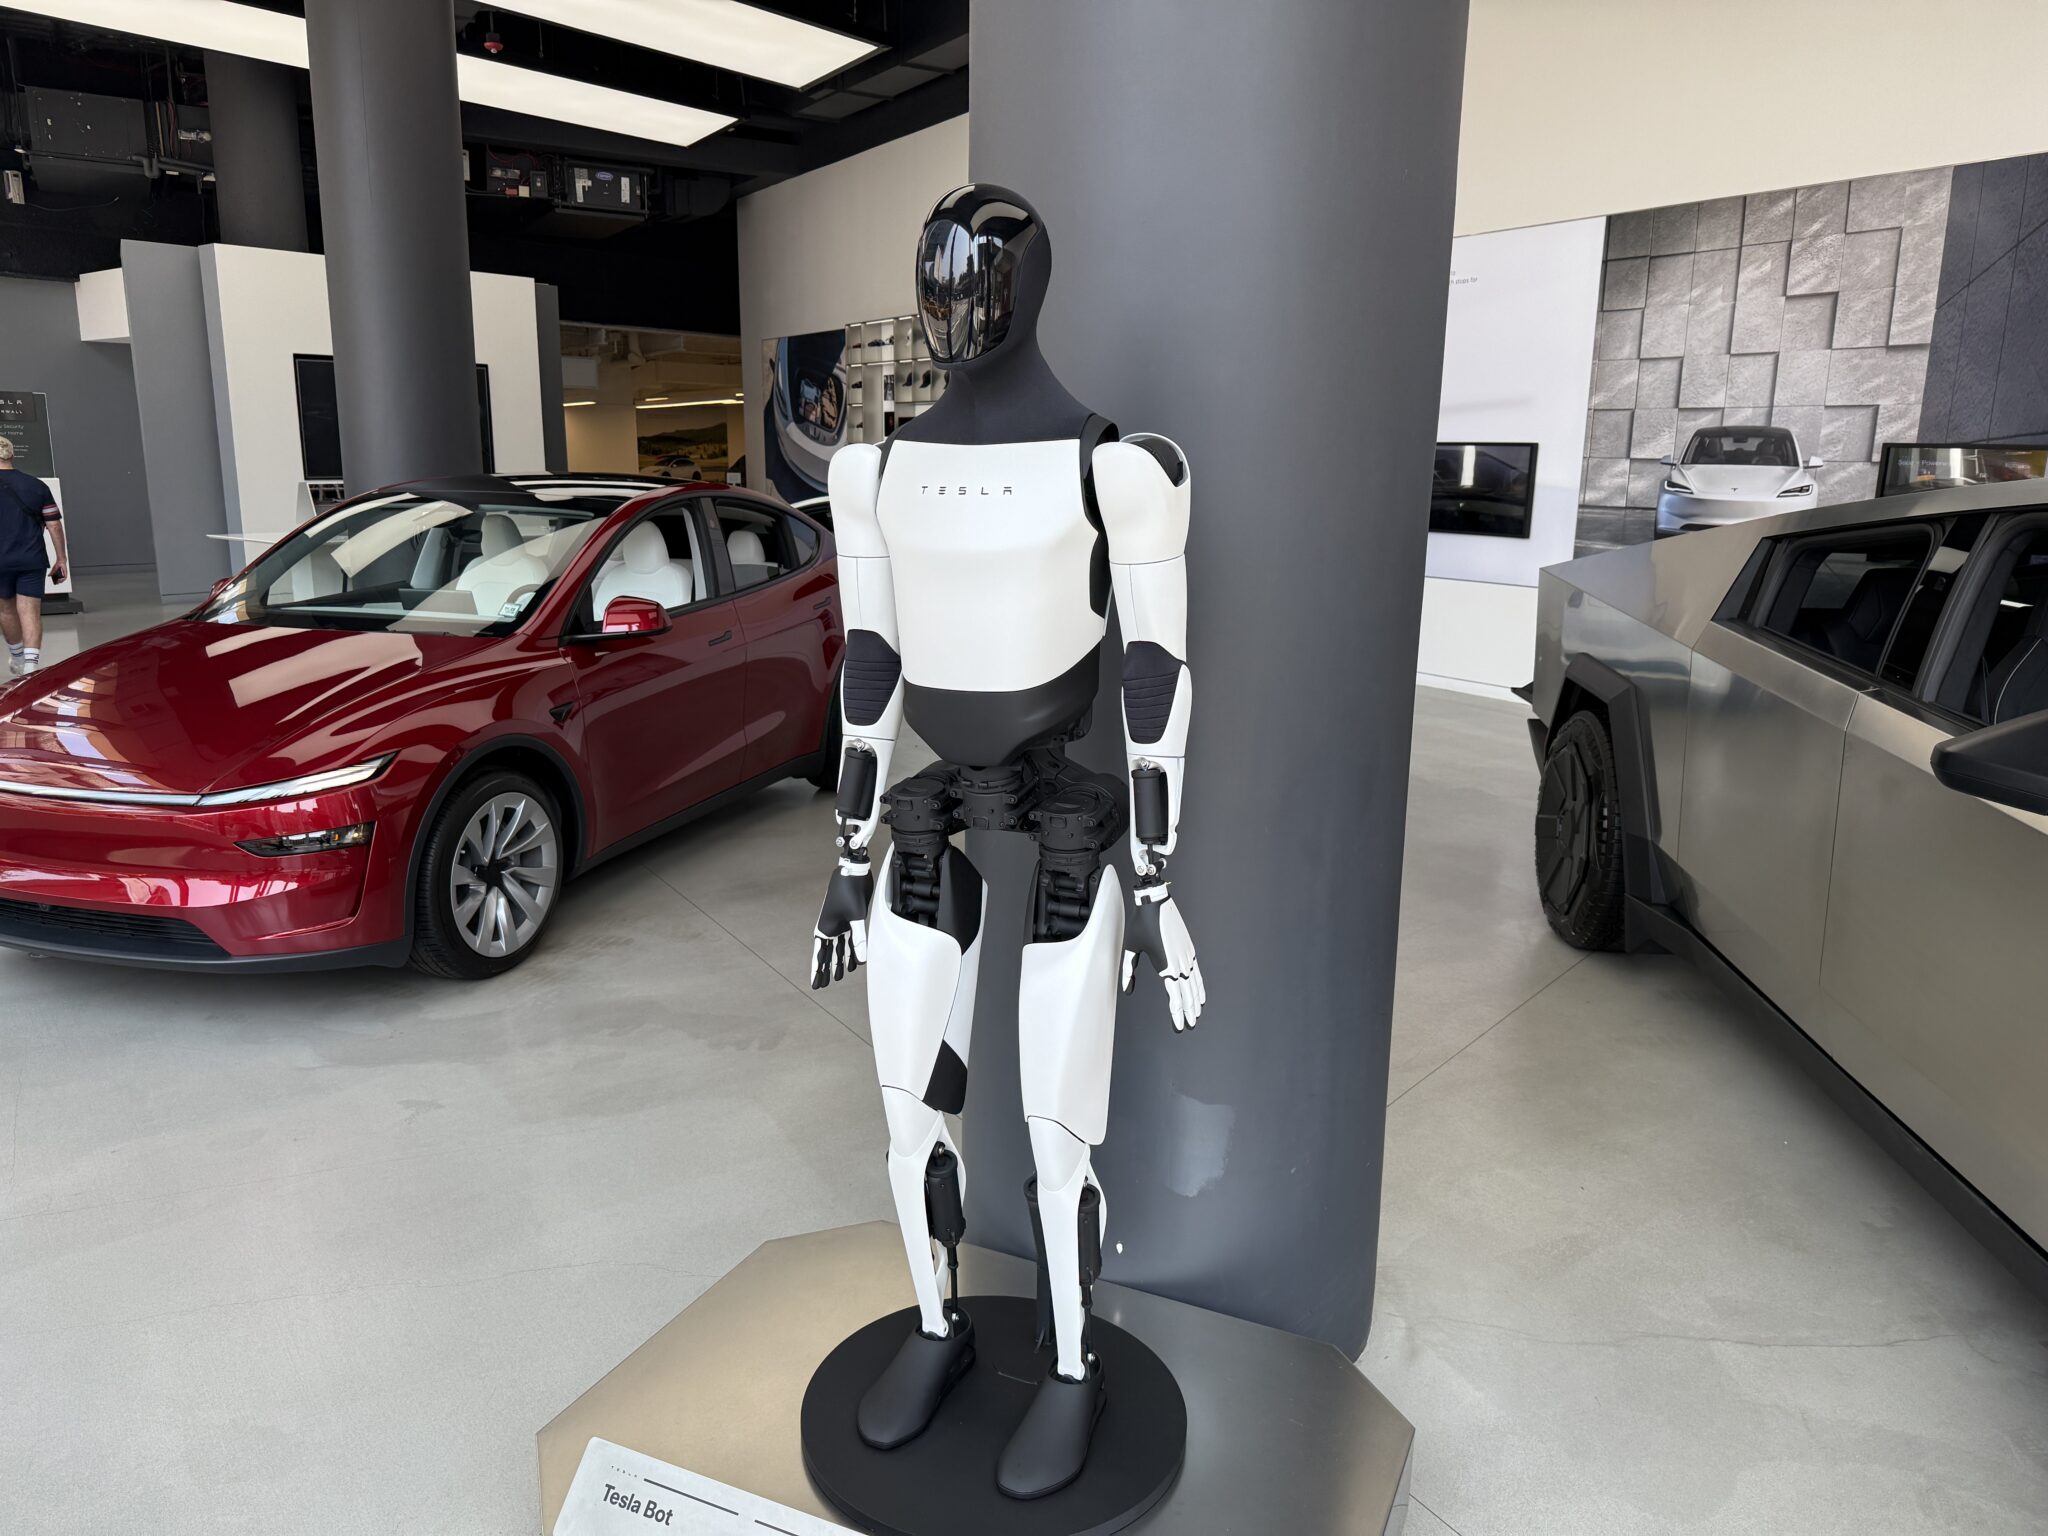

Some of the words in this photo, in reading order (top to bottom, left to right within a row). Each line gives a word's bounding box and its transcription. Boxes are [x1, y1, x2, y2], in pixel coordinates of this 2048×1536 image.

[921, 485, 1013, 496] TESLA
[603, 1483, 642, 1514] Tesla
[643, 1499, 673, 1526] Bot
